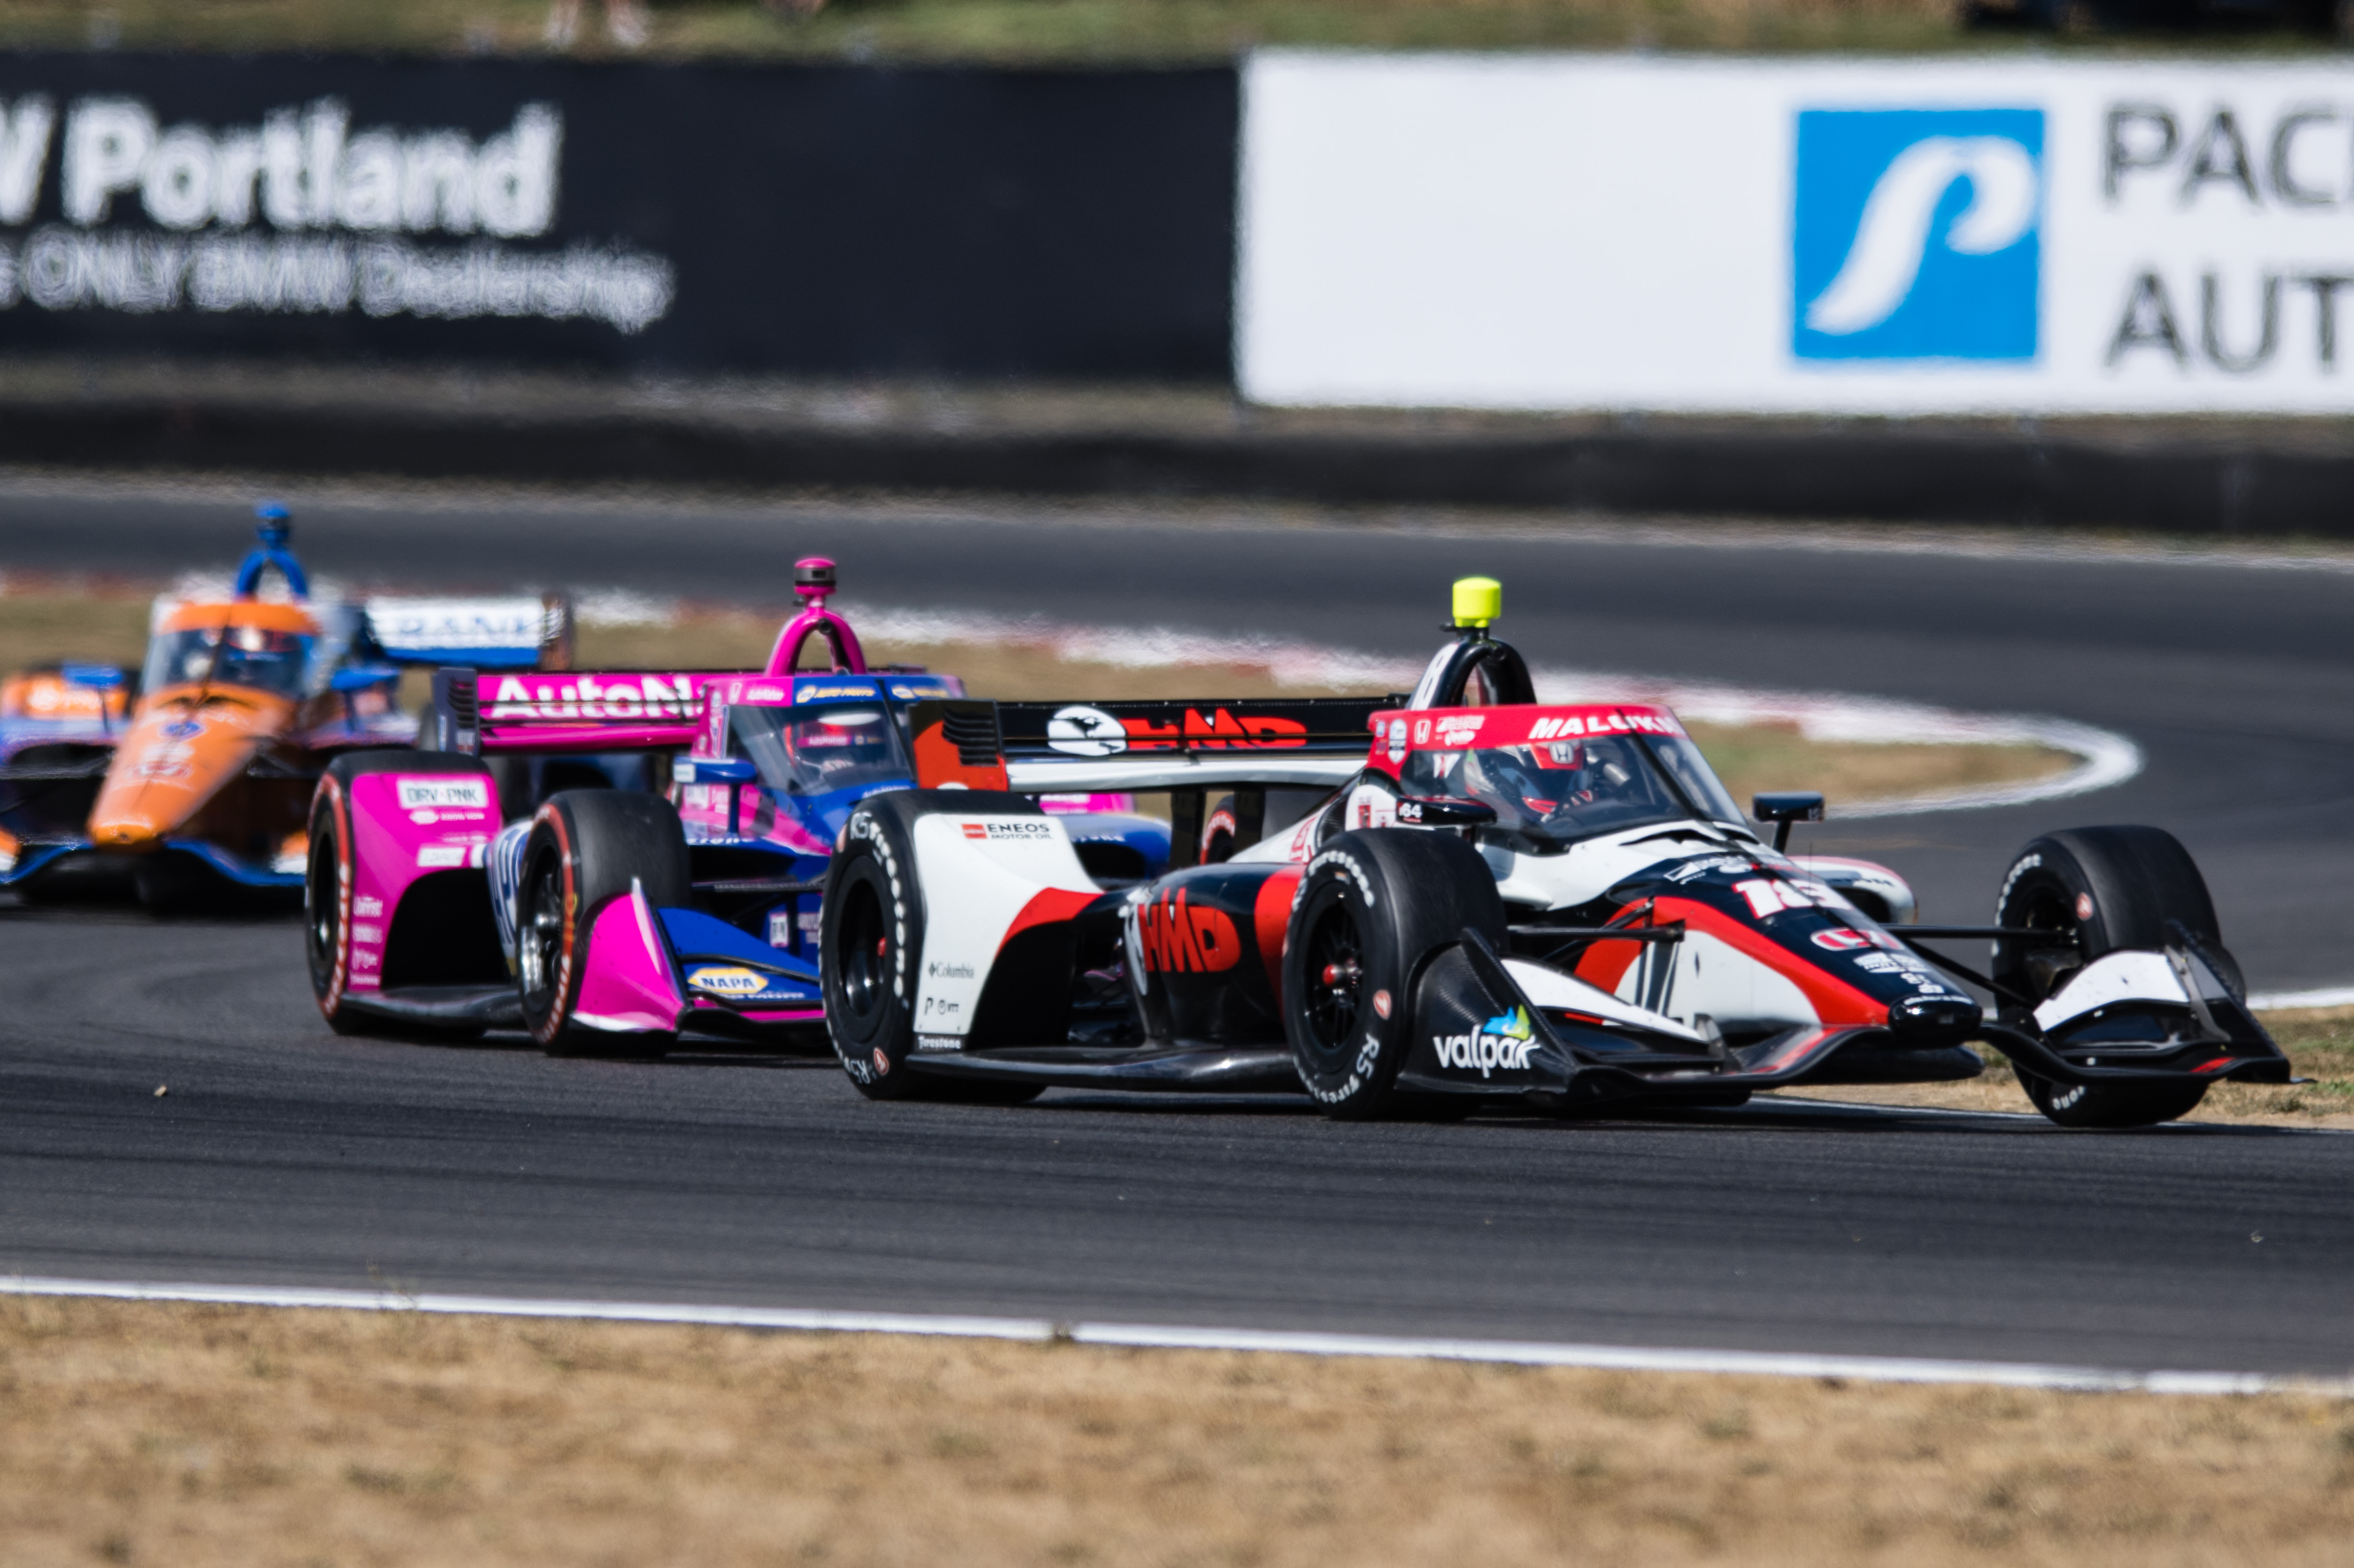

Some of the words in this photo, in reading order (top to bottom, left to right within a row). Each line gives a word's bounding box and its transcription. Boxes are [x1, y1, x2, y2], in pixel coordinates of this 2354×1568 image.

[63, 94, 565, 236] Portland
[2103, 99, 2354, 213] PAC
[357, 240, 676, 334] Dealership
[2104, 269, 2354, 375] AUT
[491, 675, 701, 719] AutoN
[407, 787, 438, 802] DRV
[446, 788, 478, 802] PNK
[466, 812, 485, 820] HOW
[986, 823, 1050, 833] ENEOS
[1137, 886, 1241, 972] HMD
[701, 977, 755, 988] NAPA
[936, 962, 975, 979] Columbia
[918, 1035, 962, 1050] Firestone
[1433, 1025, 1541, 1079] valpak
